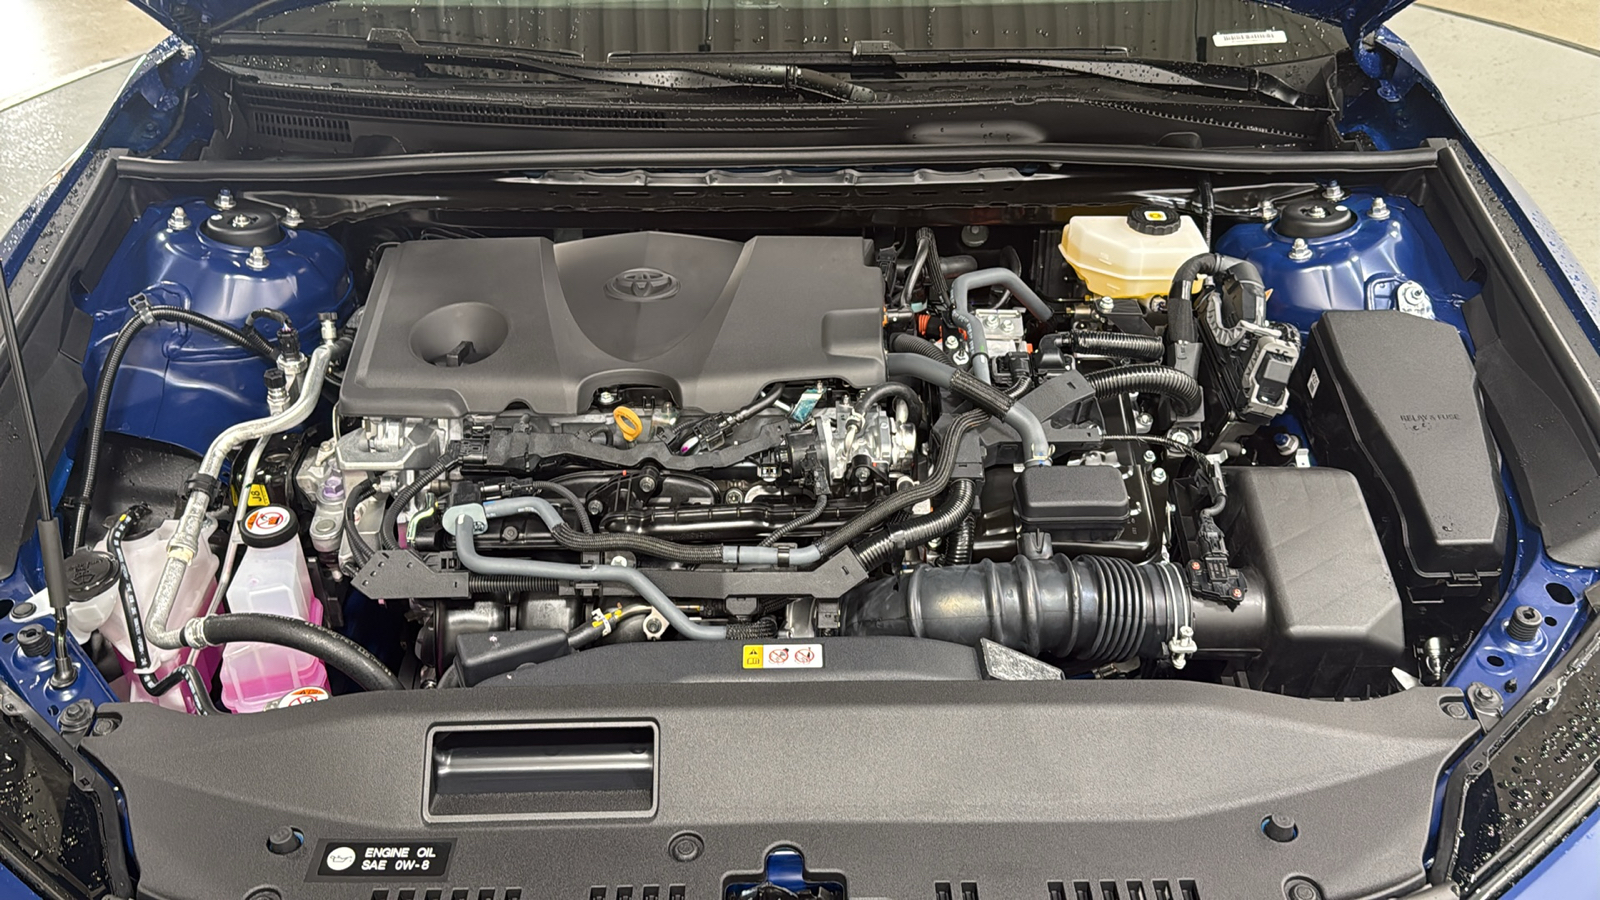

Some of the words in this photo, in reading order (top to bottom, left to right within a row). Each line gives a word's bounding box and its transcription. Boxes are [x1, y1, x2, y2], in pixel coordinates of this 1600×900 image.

[364, 847, 410, 858] ENGINE
[416, 847, 436, 858] OIL
[361, 860, 387, 871] SAE
[394, 860, 430, 871] 0W-8
